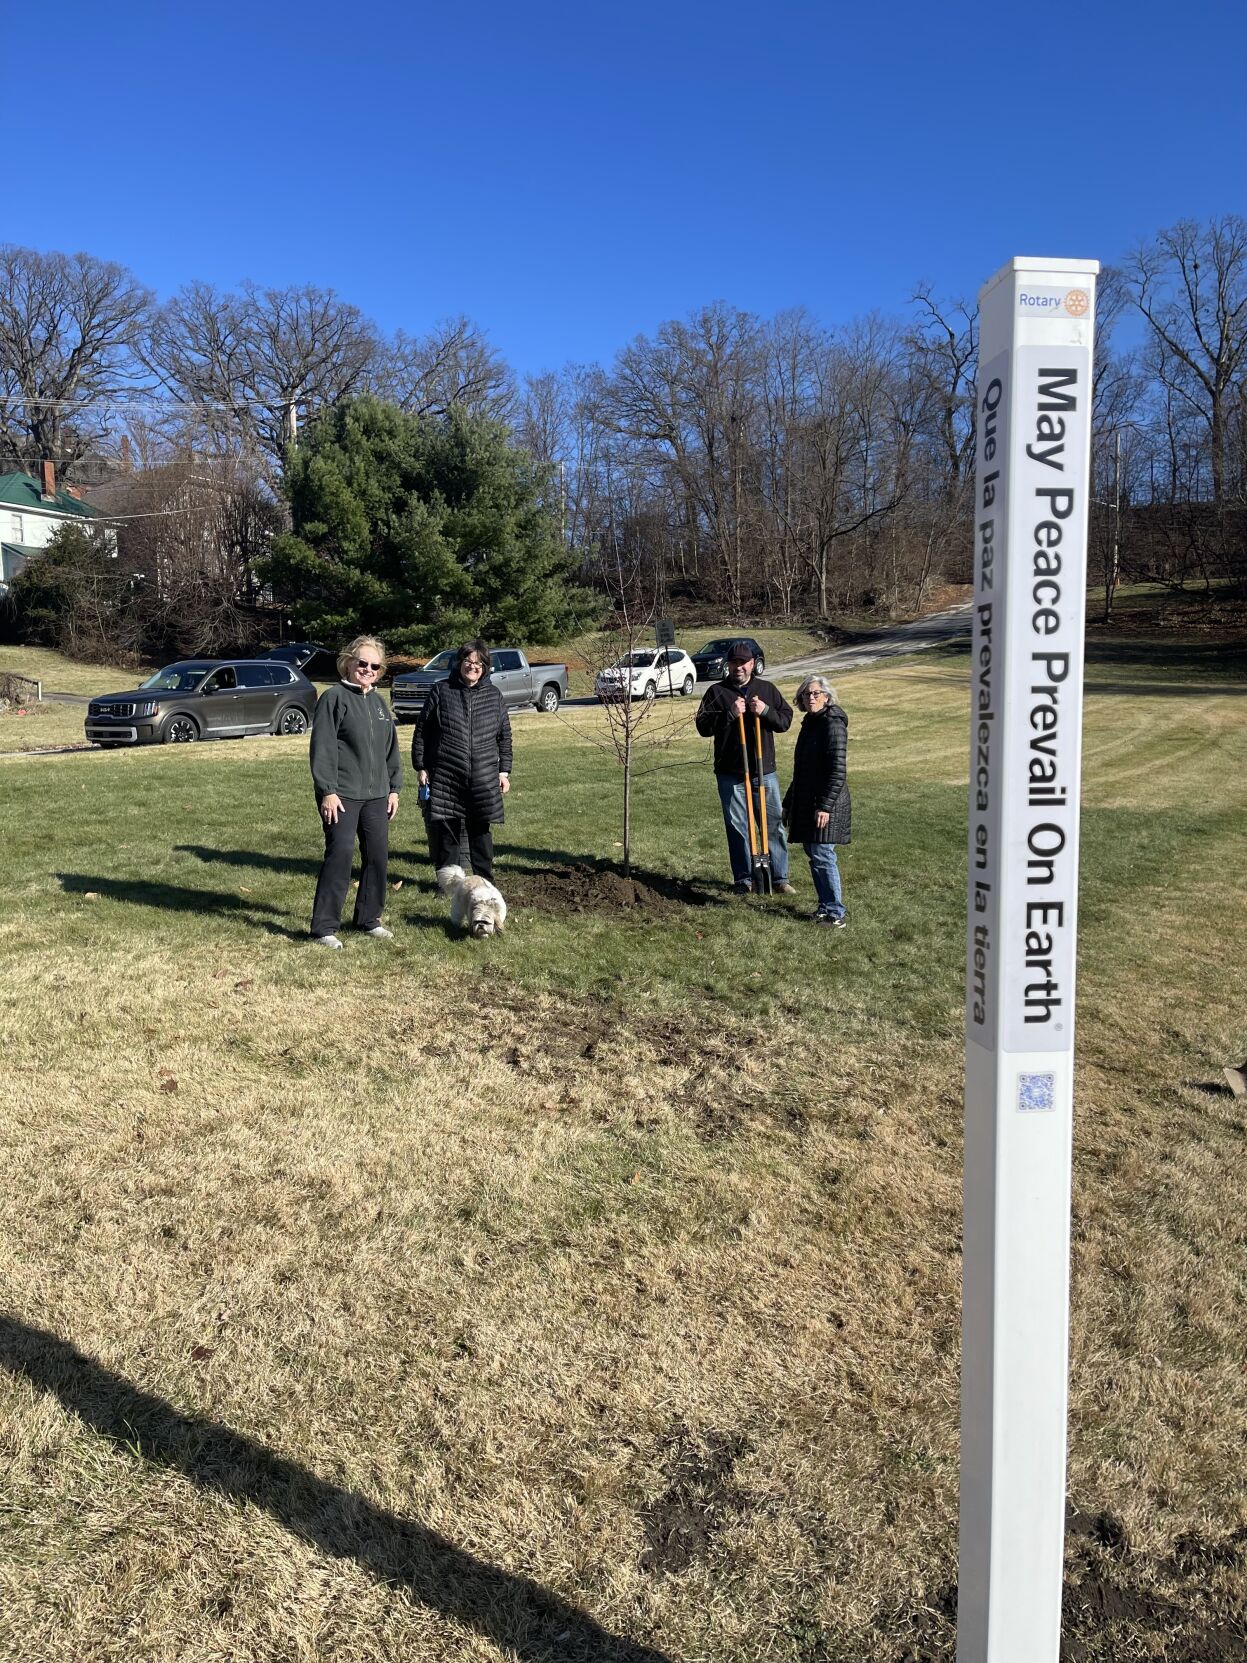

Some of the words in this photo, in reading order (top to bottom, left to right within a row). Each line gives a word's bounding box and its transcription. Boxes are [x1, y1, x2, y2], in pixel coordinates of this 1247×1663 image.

[1019, 293, 1061, 312] Rotary
[981, 377, 1003, 462] Que
[1025, 367, 1078, 472] May
[982, 469, 1000, 510] la
[979, 518, 995, 593] paz
[1031, 487, 1075, 636] Peace
[975, 602, 995, 812] prevalezca
[1028, 652, 1070, 807] Prevail
[974, 823, 989, 871] en
[1026, 822, 1066, 886] On
[973, 879, 991, 914] la
[972, 924, 991, 1026] tierra
